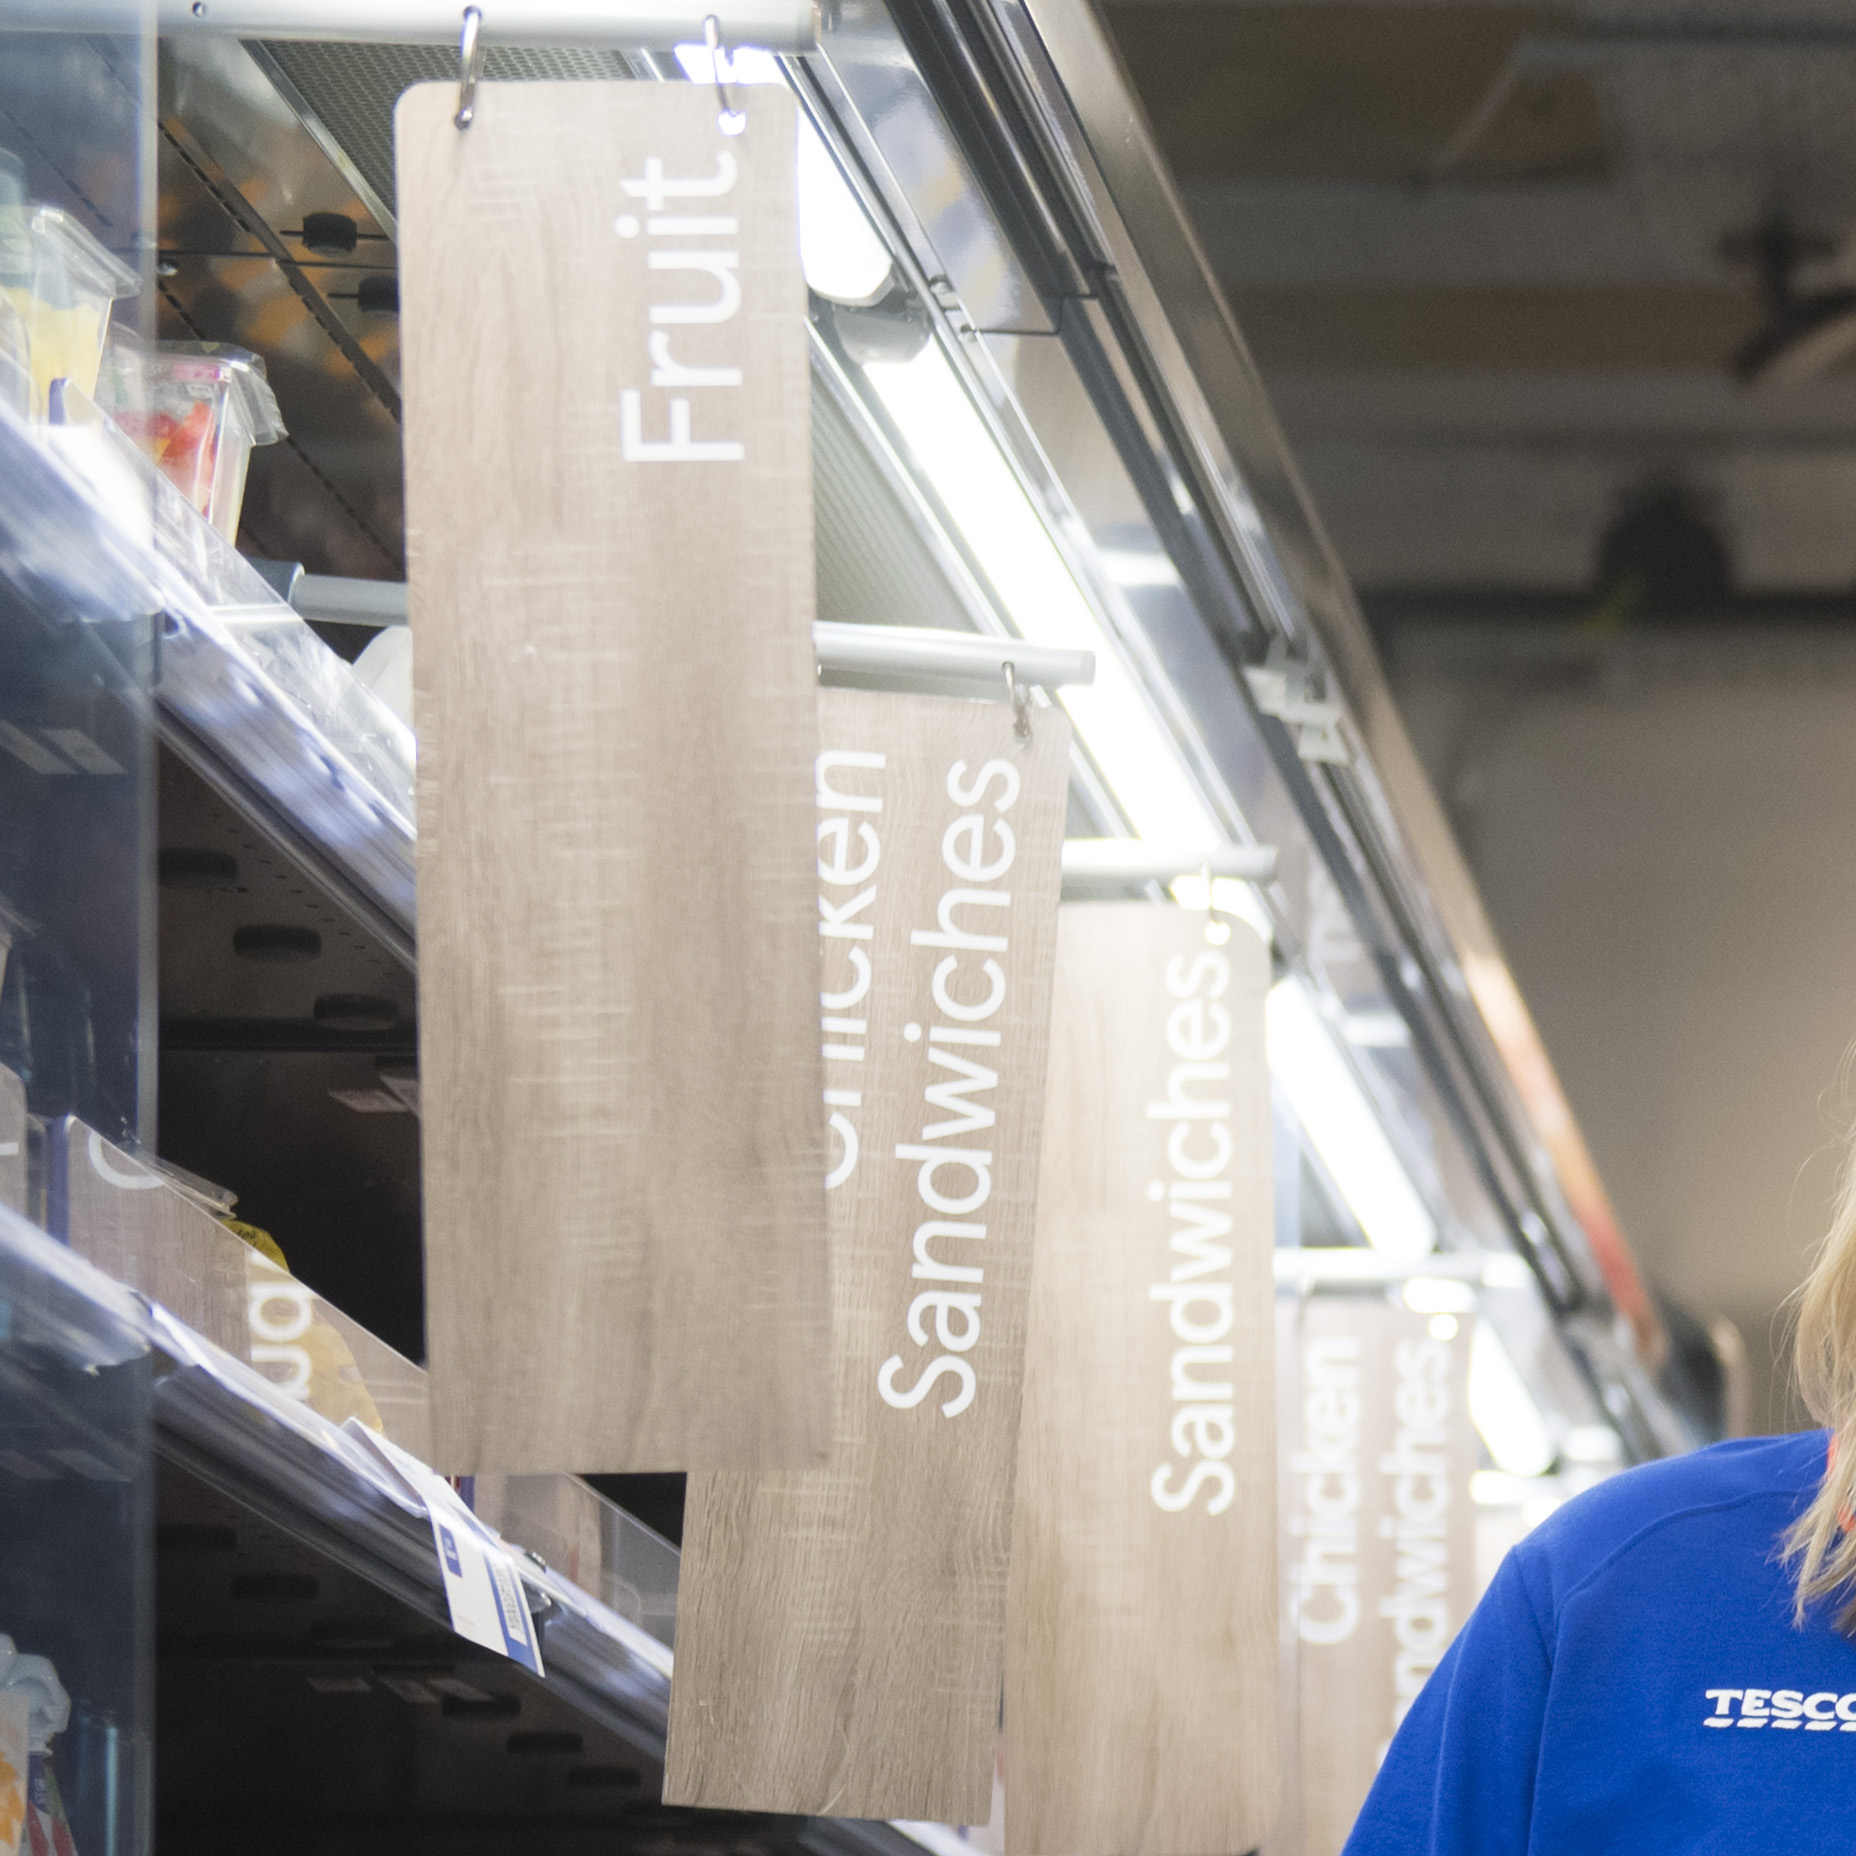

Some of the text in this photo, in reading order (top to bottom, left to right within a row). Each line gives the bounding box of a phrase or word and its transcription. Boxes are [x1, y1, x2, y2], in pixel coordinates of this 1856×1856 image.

[614, 151, 745, 462] Fruit
[877, 756, 1020, 1419] Sandwiches
[1146, 949, 1235, 1516] Sandwiches
[1288, 1337, 1360, 1646] Chicken
[1378, 1339, 1453, 1772] ndwiches
